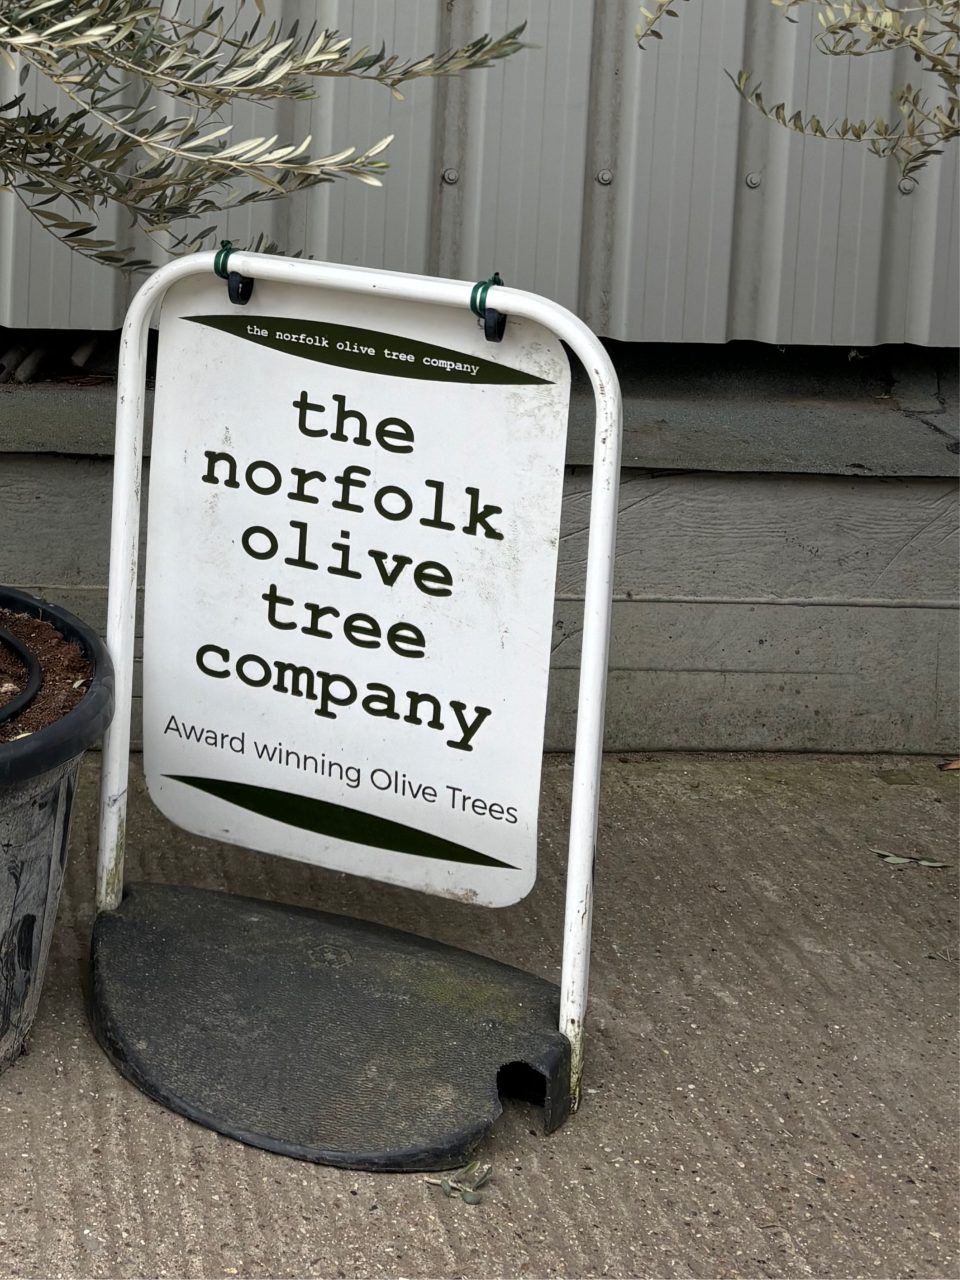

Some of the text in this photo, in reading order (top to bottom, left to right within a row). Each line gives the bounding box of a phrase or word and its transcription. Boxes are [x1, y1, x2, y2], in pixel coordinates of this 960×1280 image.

[246, 324, 480, 375] the norfolk olive tree company
[292, 390, 415, 454] the
[201, 450, 505, 541] norfolk
[241, 520, 453, 598] olive
[261, 583, 426, 659] tree
[195, 644, 492, 752] company
[163, 715, 518, 824] Award winning Olive Trees
